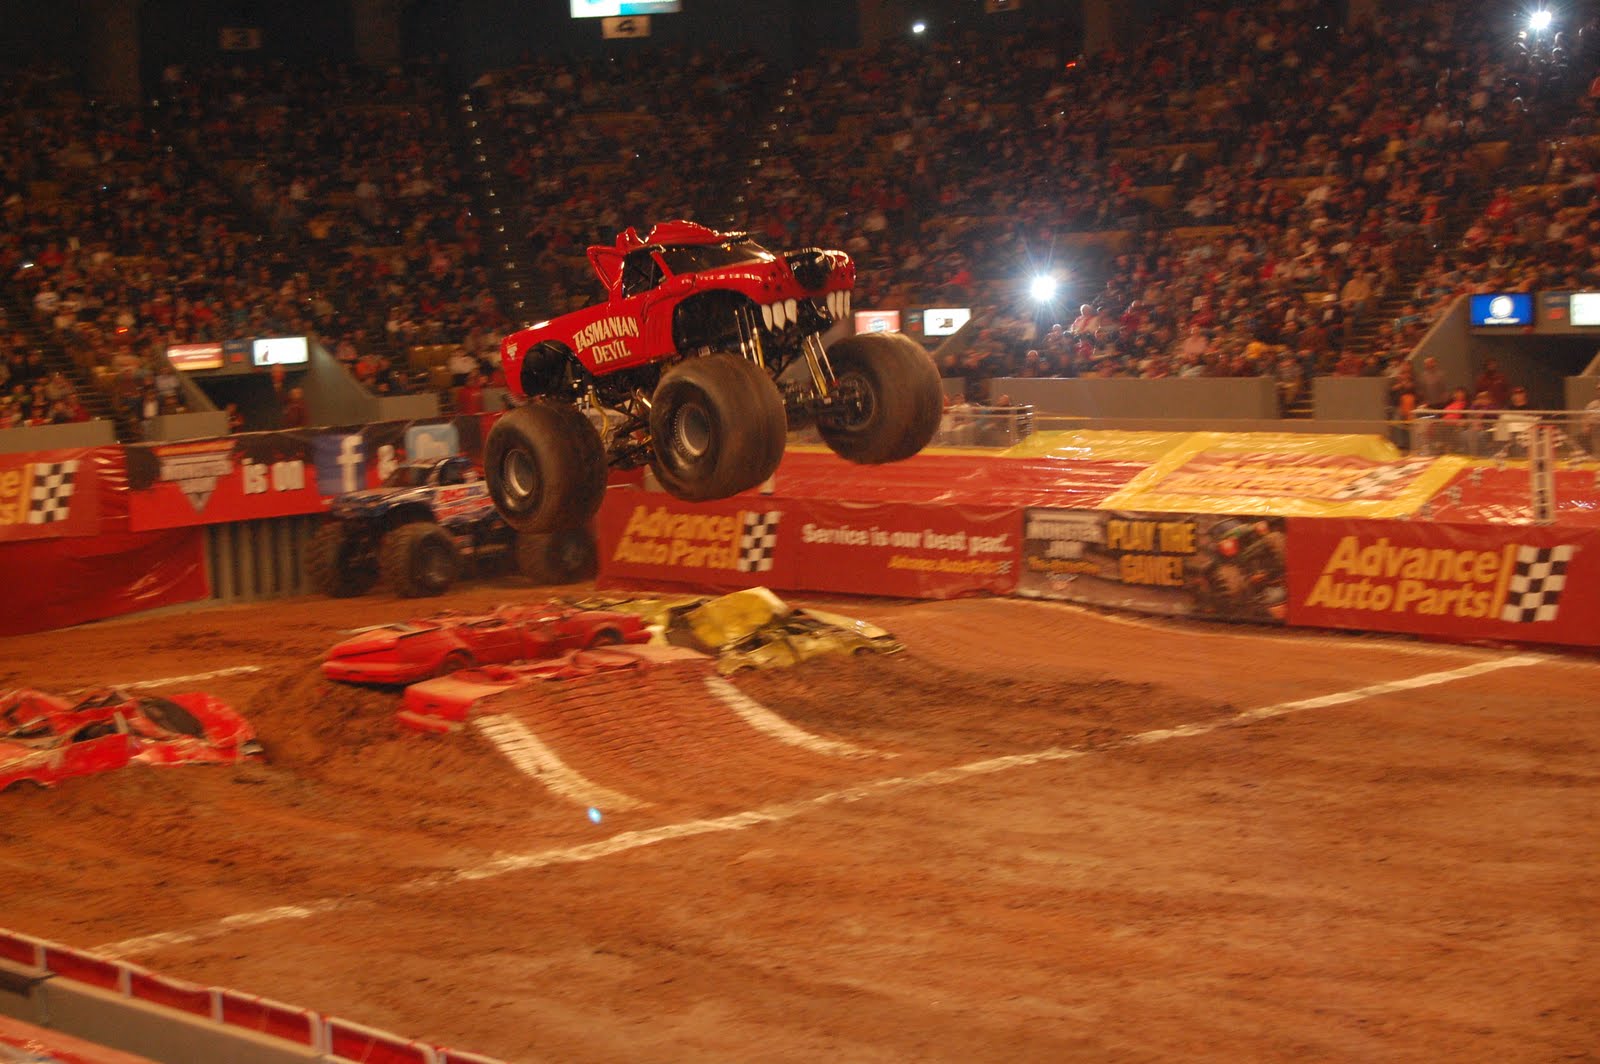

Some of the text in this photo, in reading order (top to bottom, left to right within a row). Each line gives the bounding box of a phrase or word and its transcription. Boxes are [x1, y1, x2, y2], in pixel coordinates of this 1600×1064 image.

[572, 316, 639, 354] TASMANIAN
[592, 339, 632, 364] DEVIL
[623, 505, 737, 541] Advance
[612, 536, 735, 569] Auto Parts
[1323, 536, 1499, 583] Advance
[1304, 575, 1491, 618] Auto Parts
